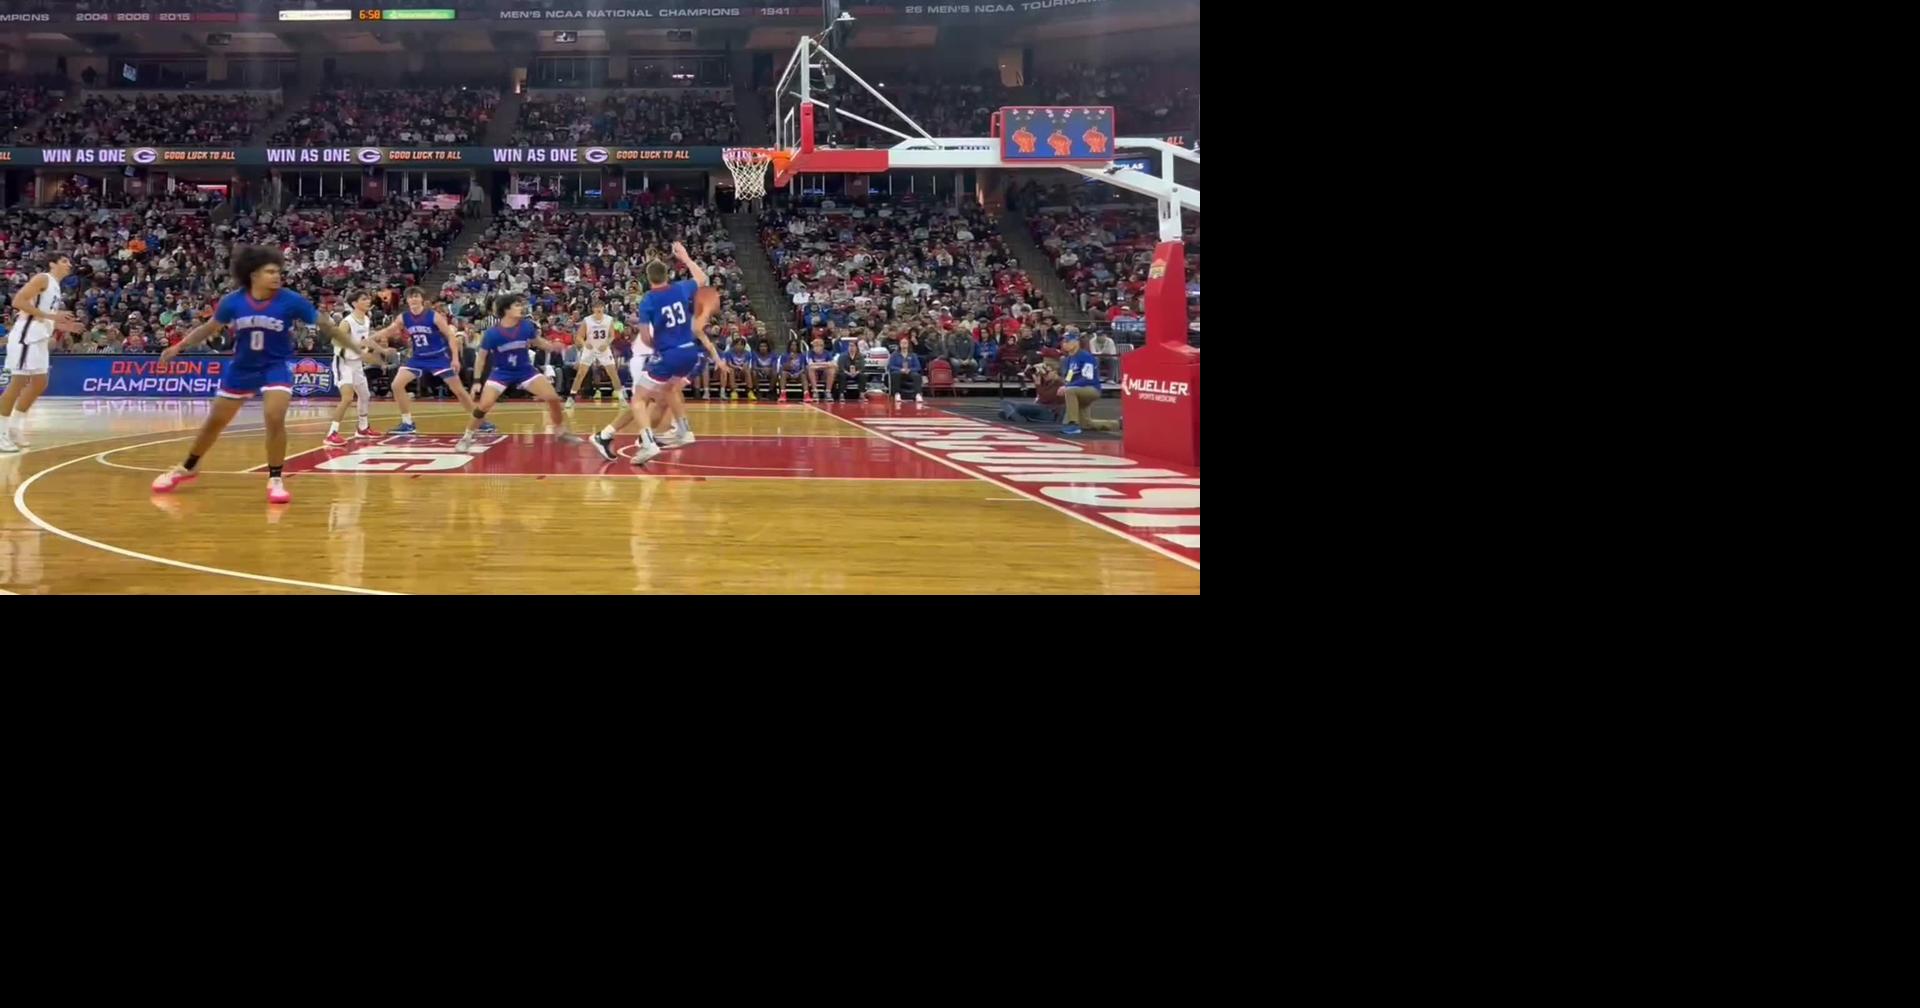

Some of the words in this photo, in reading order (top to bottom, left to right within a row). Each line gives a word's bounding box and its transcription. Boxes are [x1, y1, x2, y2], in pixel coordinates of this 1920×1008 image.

[359, 10, 381, 20] 6:58
[500, 11, 542, 19] MEN'S
[545, 10, 583, 18] NCAA
[586, 9, 653, 18] NATIONAL
[659, 8, 740, 17] CHAMPIONS
[761, 7, 790, 16] 1941
[905, 5, 923, 14] 26
[927, 5, 970, 14] MEN'S
[974, 5, 1015, 13] NCAA
[75, 13, 108, 21] 2004
[159, 13, 191, 21] 2015
[42, 150, 71, 162] WIN
[76, 150, 95, 162] AS
[99, 150, 126, 162] ONE
[164, 151, 185, 160] GOOD
[187, 151, 208, 160] LUCK
[210, 151, 220, 160] TO
[221, 151, 236, 160] ALL
[267, 149, 296, 162] WIN
[300, 149, 319, 162] AS
[323, 149, 350, 162] ONE
[389, 151, 411, 160] GOOD
[413, 151, 433, 160] LUCK
[435, 151, 445, 160] TO
[447, 151, 462, 160] ALL
[493, 149, 522, 162] WIN
[527, 149, 546, 162] AS
[551, 149, 577, 162] ONE
[616, 150, 638, 160] GOOD
[640, 150, 661, 160] LUCK
[663, 150, 673, 160] TO
[674, 150, 689, 160] ALL
[661, 301, 686, 328] 33
[413, 334, 430, 347] 23
[593, 330, 606, 339] 33
[250, 331, 264, 351] 0
[111, 362, 201, 375] DIVISION
[207, 362, 221, 375] 2
[1129, 379, 1189, 396] MUELLER
